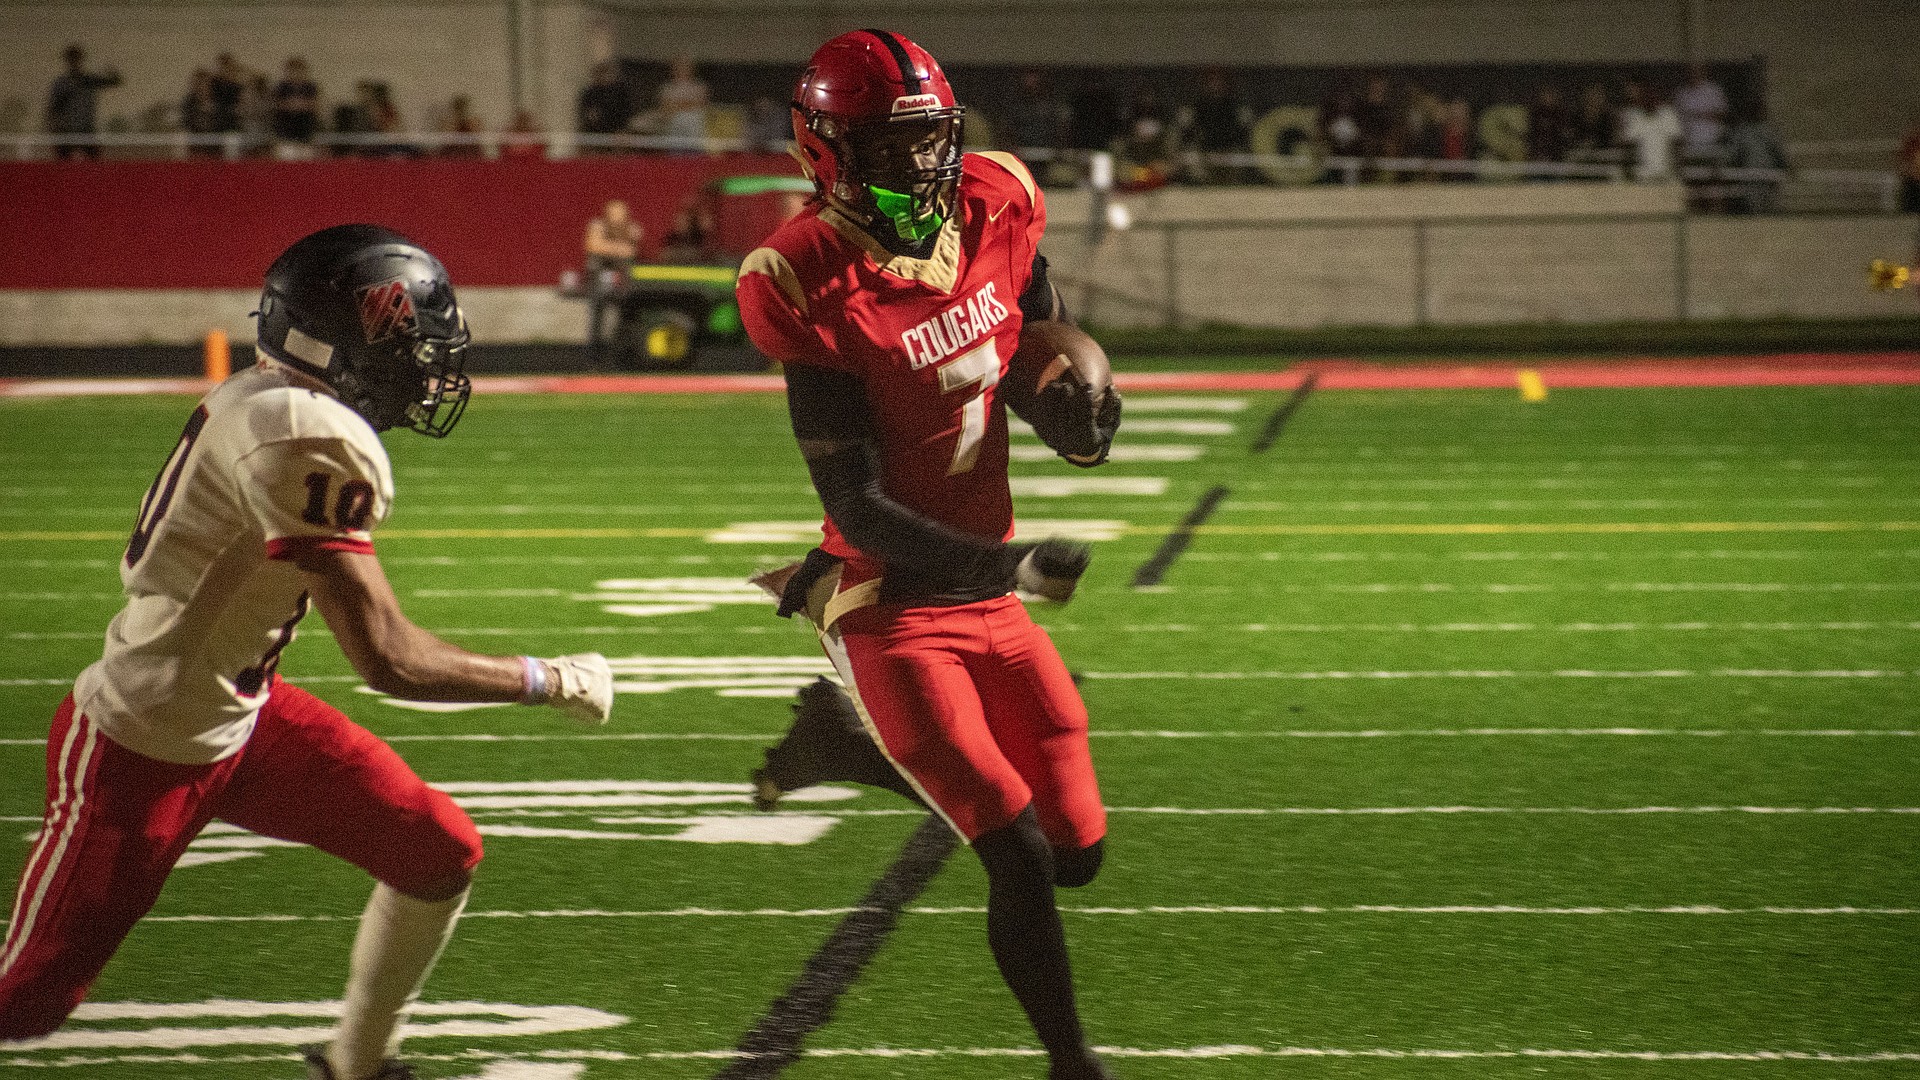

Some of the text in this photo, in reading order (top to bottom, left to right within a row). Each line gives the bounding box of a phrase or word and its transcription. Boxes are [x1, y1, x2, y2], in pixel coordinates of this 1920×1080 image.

[898, 97, 936, 109] Riddell
[902, 281, 1008, 370] COUGARS
[937, 336, 1001, 476] 7
[301, 471, 375, 532] 10
